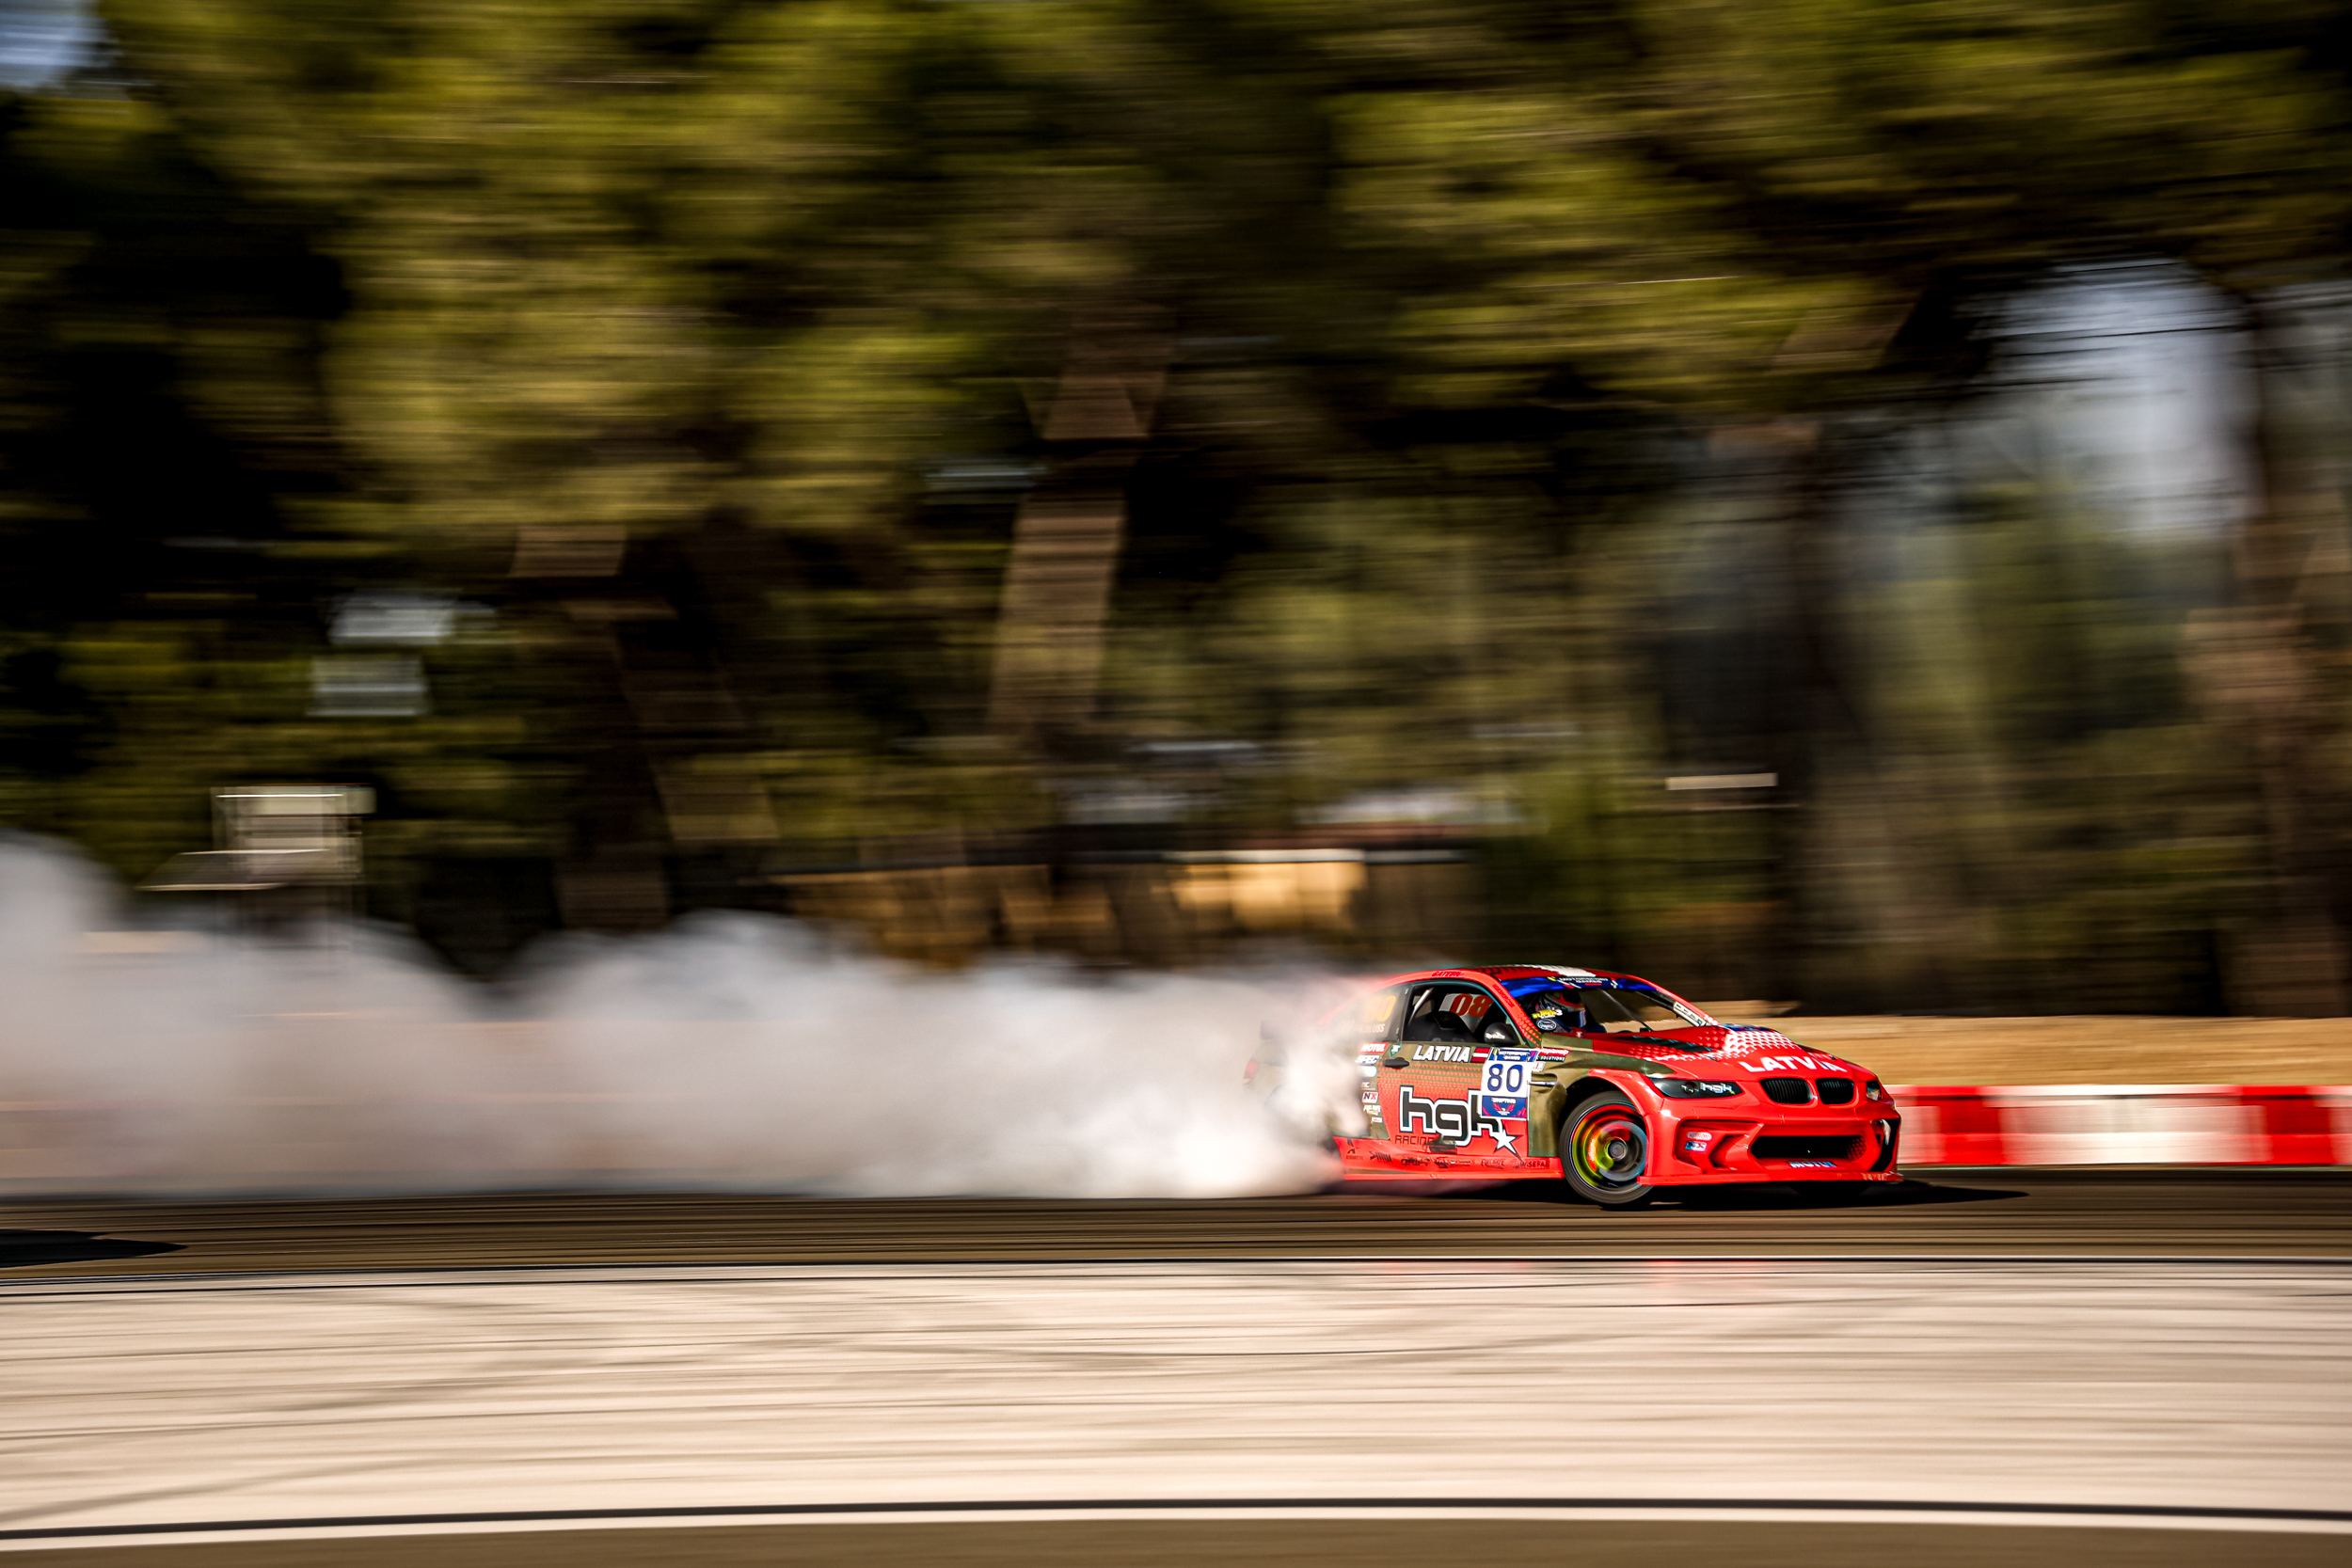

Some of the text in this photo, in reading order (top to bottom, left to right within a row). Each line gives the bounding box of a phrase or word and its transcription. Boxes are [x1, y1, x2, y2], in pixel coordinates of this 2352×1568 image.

[1359, 1043, 1386, 1053] MOTUL
[1412, 1045, 1470, 1063] LATVIA
[1738, 1055, 1848, 1072] LATVIA
[1487, 1064, 1523, 1092] 80
